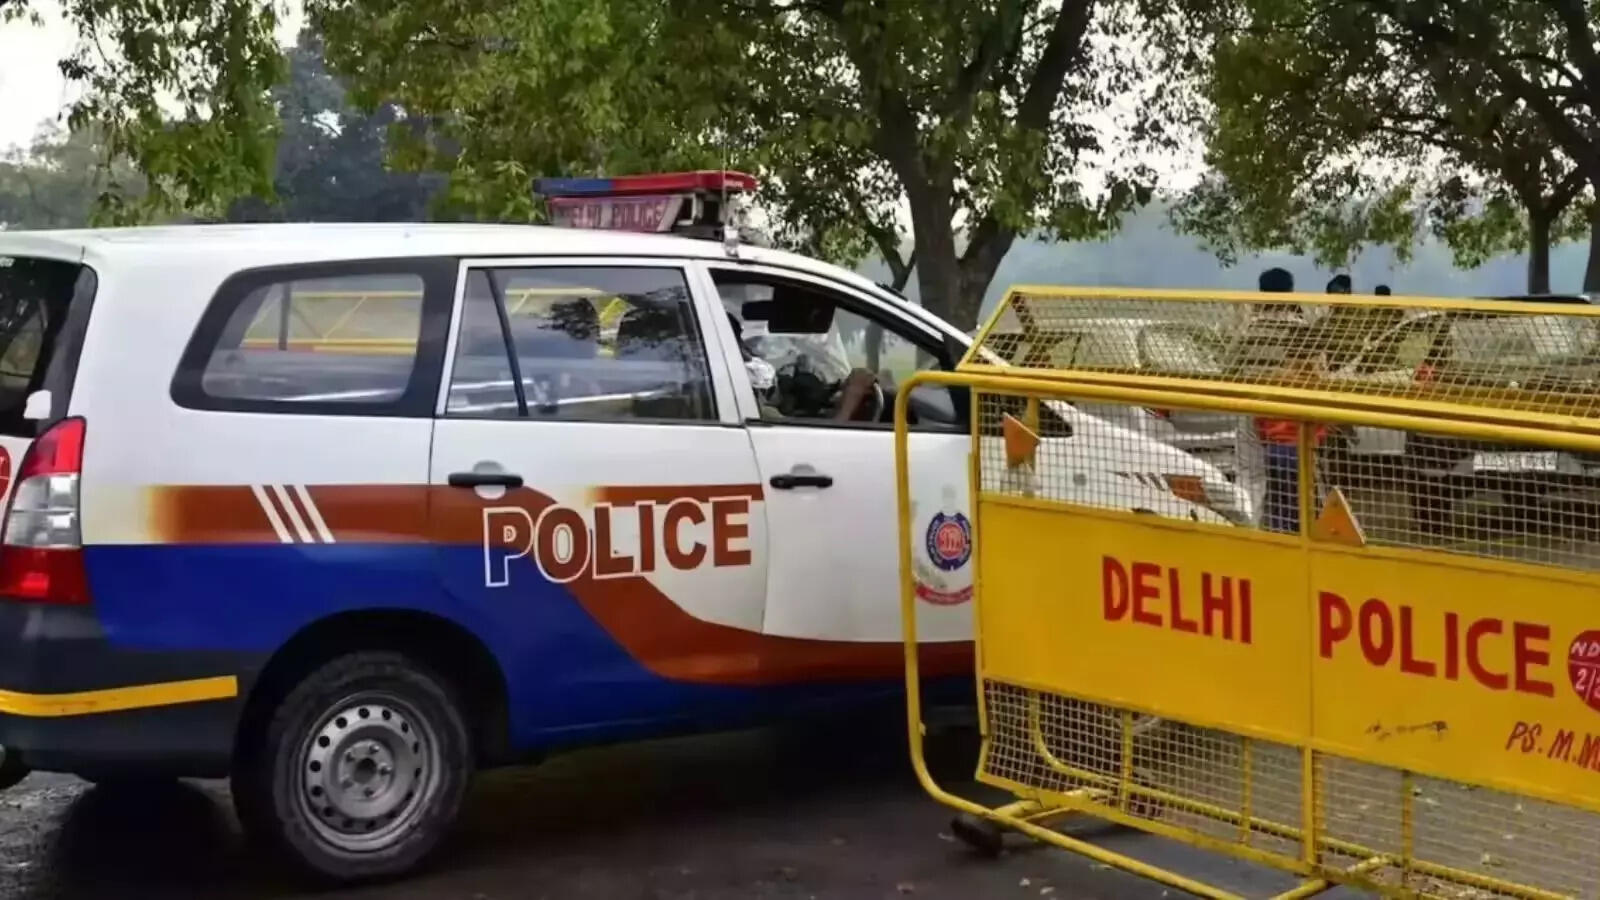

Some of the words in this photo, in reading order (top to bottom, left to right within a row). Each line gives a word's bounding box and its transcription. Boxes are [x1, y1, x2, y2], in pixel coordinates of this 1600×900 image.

[482, 495, 752, 587] POLICE
[1102, 555, 1252, 645] DELHI
[1318, 591, 1555, 698] POLICE
